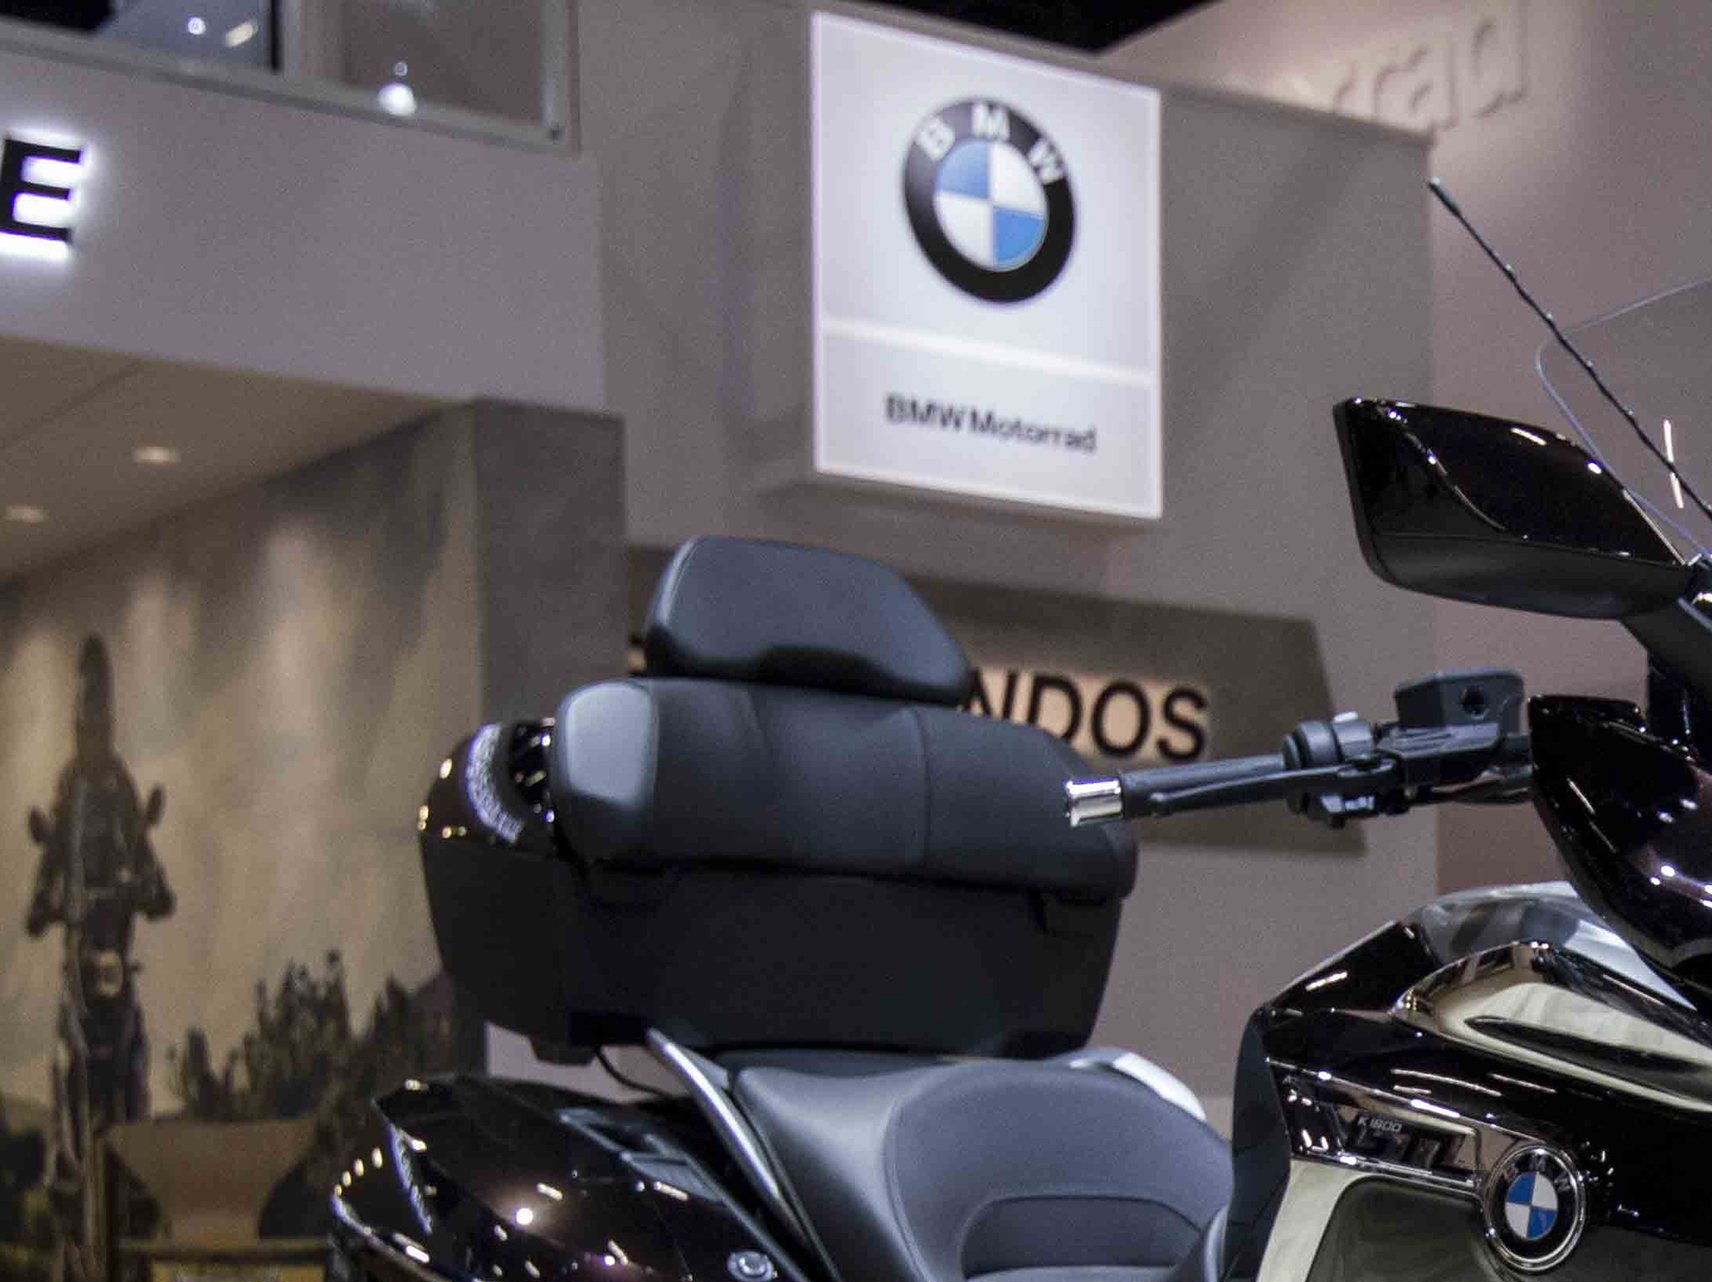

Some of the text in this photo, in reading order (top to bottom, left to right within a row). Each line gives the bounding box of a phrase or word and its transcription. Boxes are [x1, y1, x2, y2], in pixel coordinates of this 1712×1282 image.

[914, 101, 1066, 187] BMW
[885, 393, 1098, 454] BMW Motorrad
